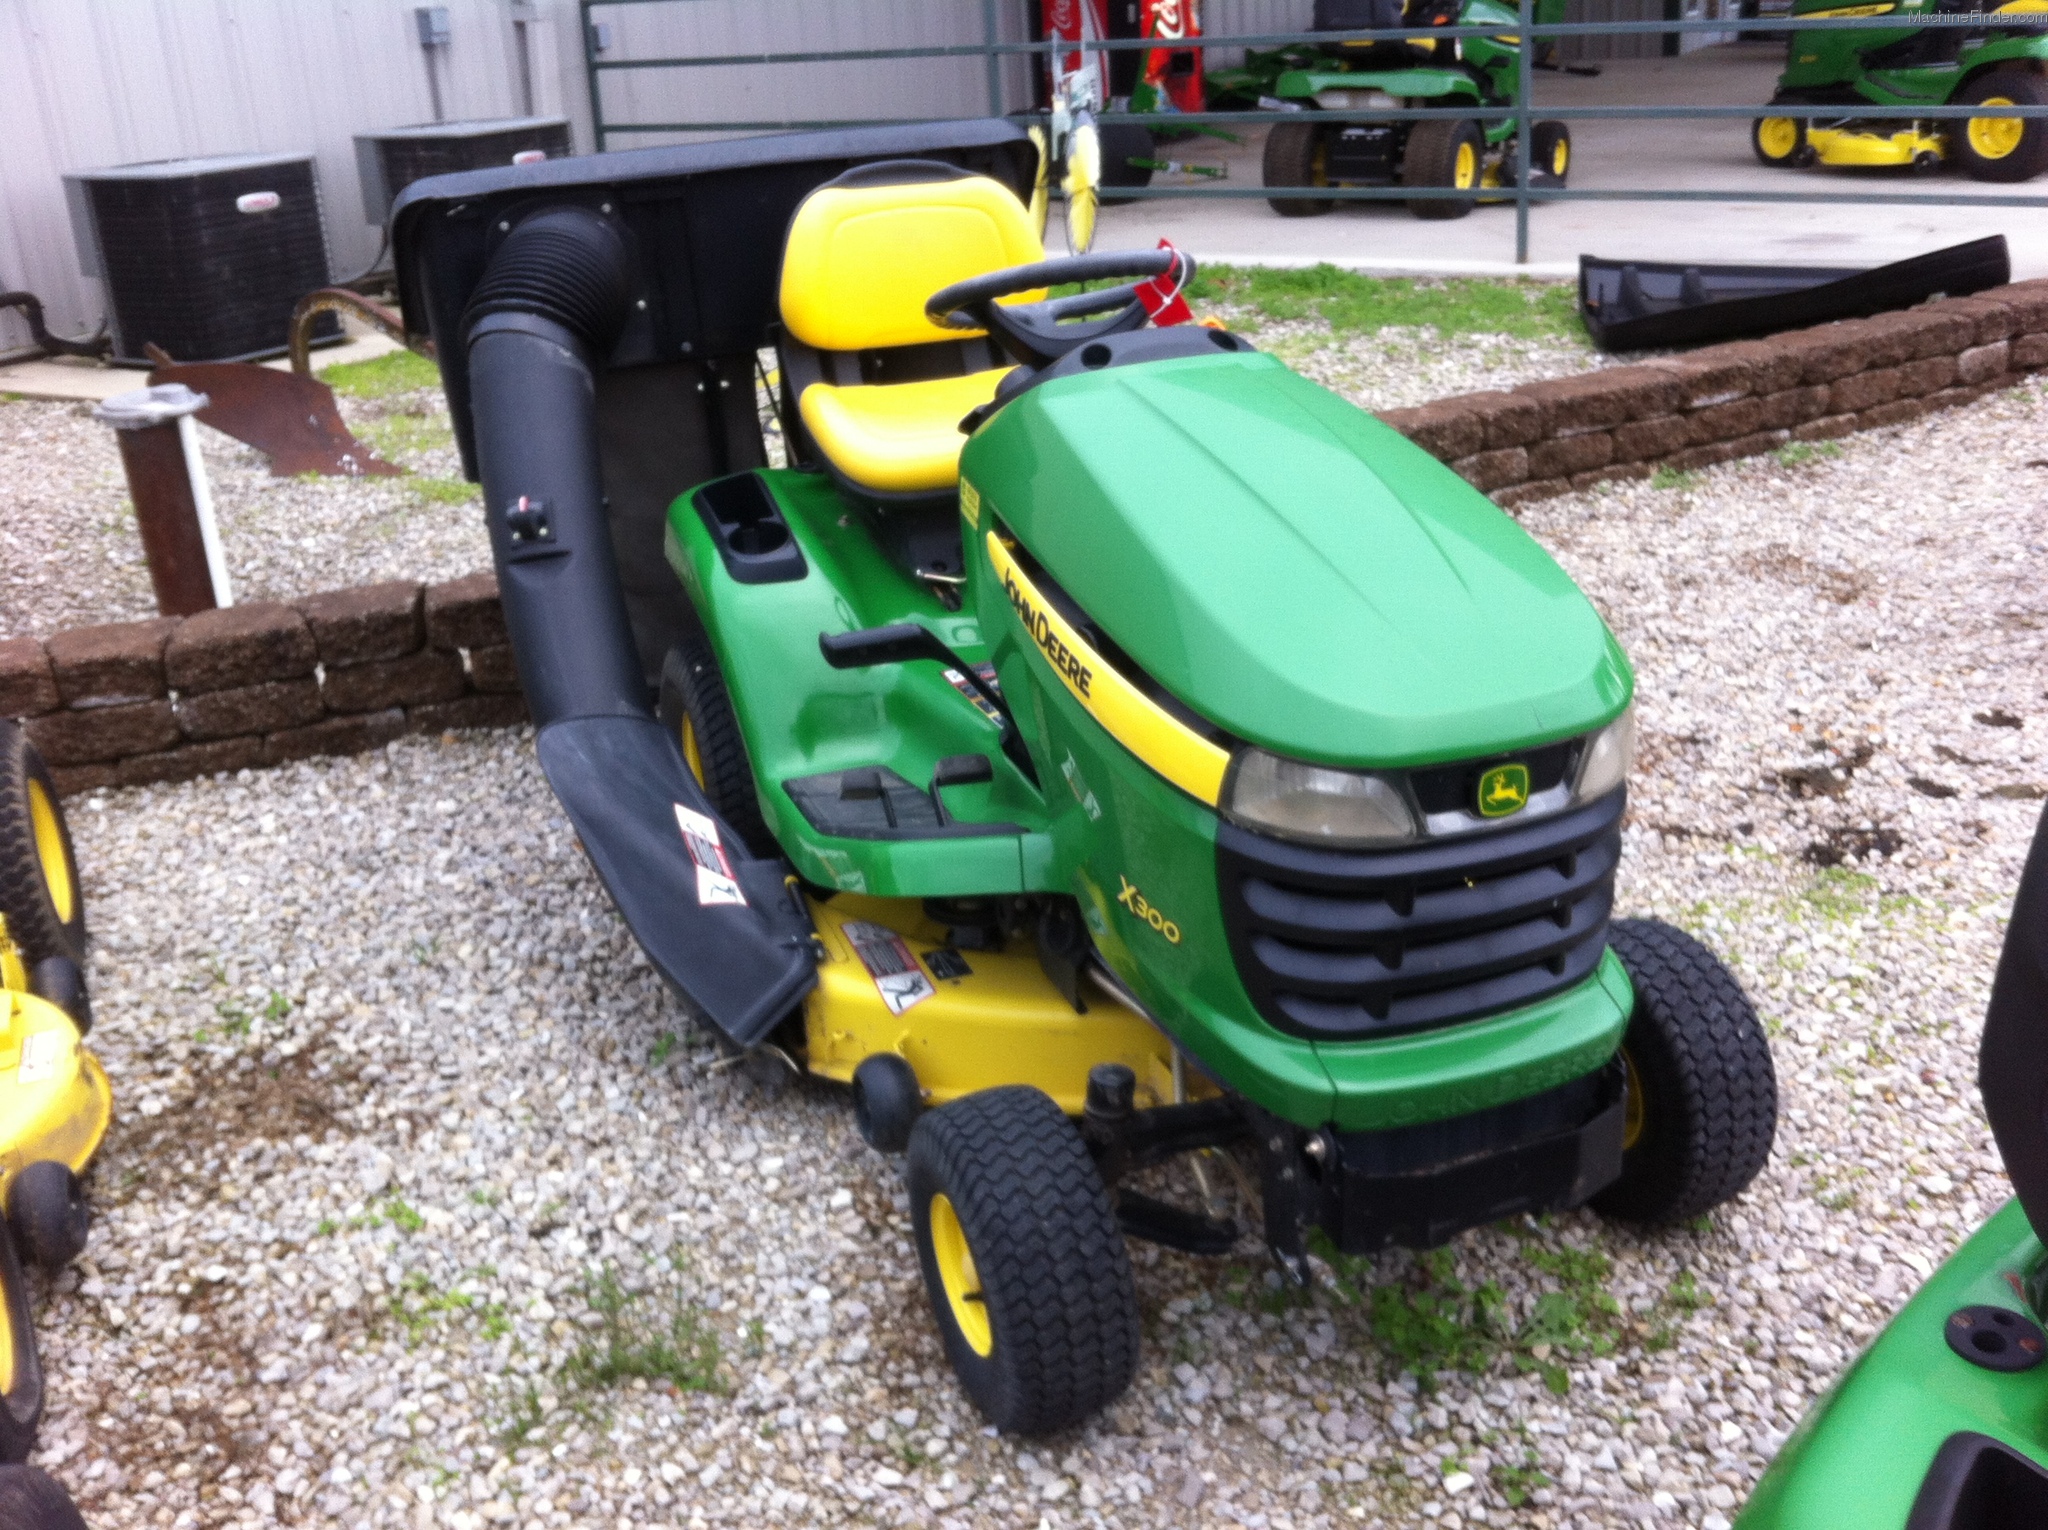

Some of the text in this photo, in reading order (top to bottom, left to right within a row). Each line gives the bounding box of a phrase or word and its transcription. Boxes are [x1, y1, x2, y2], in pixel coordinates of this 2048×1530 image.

[1003, 566, 1093, 700] JOHN DEERE
[1117, 874, 1181, 944] X300
